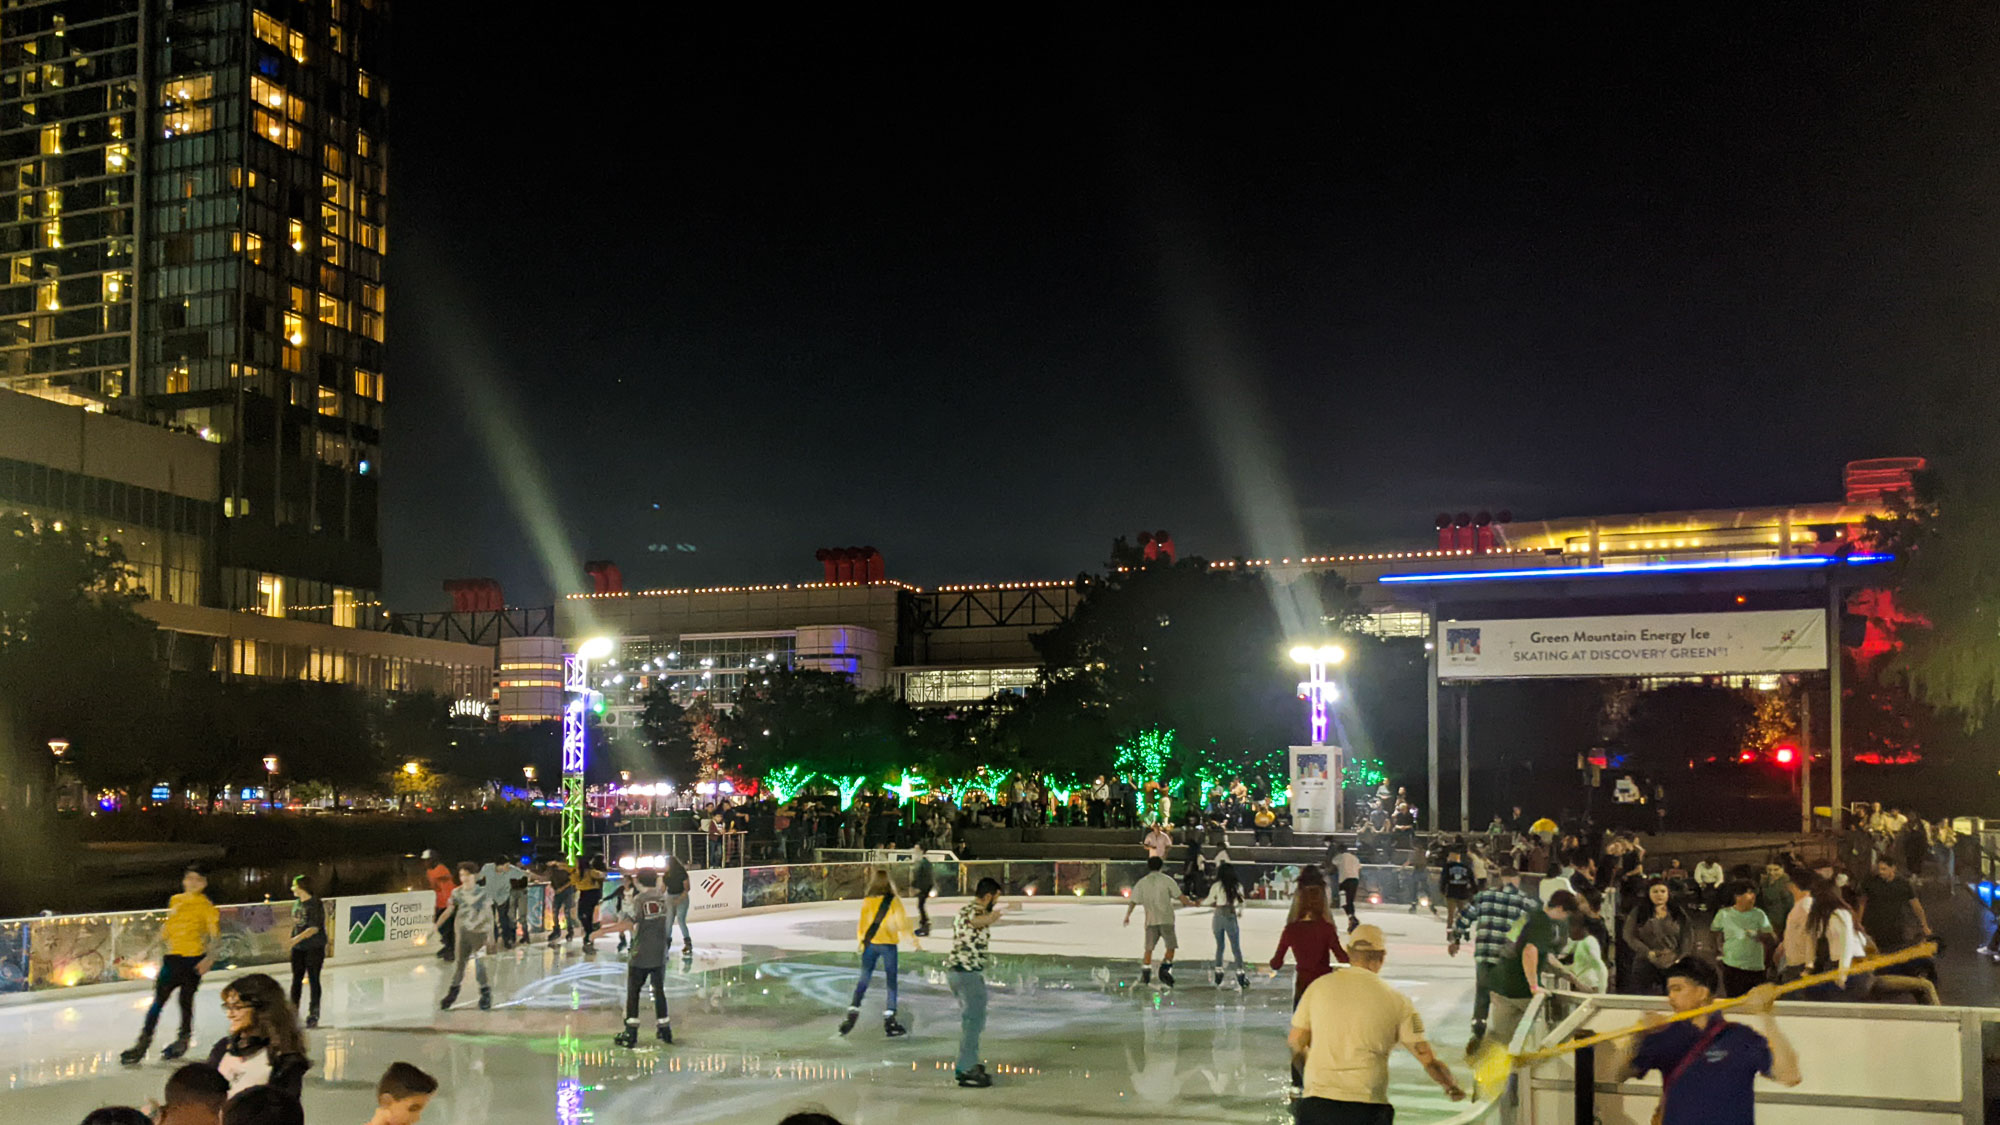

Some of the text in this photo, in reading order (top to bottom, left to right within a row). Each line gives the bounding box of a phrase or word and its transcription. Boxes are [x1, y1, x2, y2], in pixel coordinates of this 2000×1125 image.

[1530, 627, 1710, 644] Green Mountain Energy Ice
[1513, 650, 1568, 662] SKATING
[1571, 650, 1588, 660] AT
[1590, 648, 1667, 660] DISCOVERY
[391, 902, 422, 914] Green
